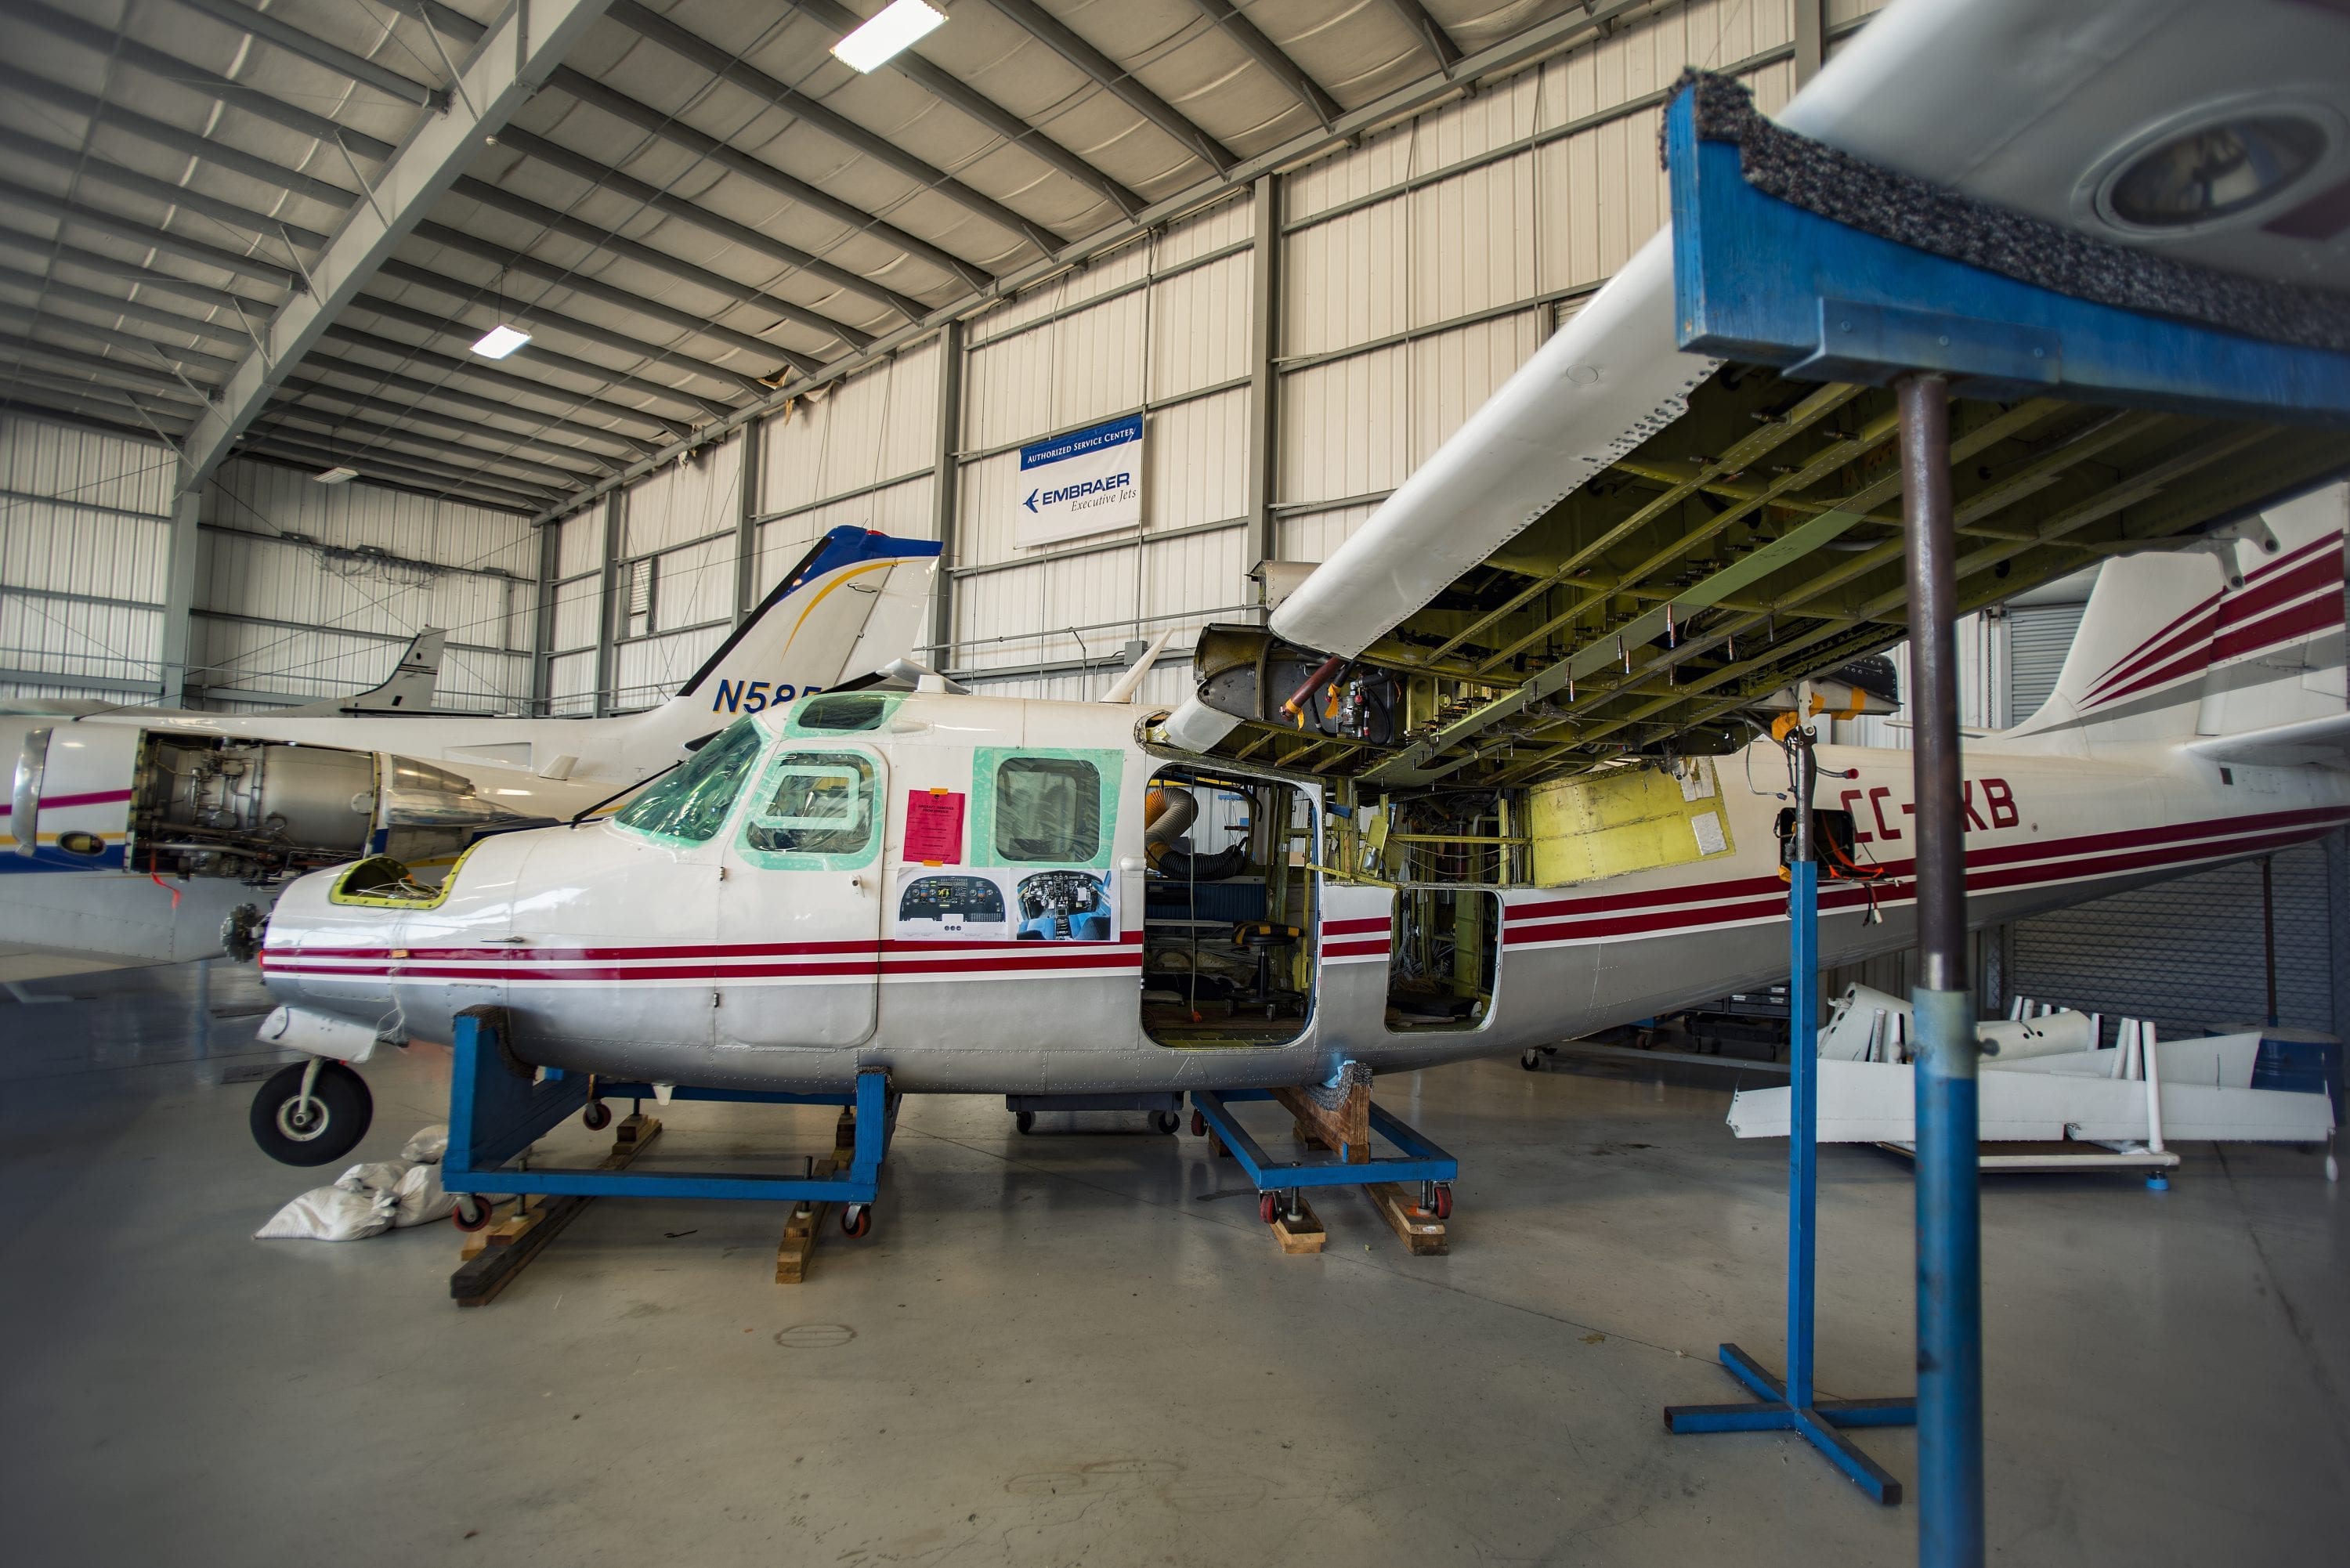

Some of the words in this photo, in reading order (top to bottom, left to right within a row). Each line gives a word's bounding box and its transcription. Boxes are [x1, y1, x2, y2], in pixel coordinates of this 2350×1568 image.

[1027, 446, 1072, 464] AUTHORIZED
[1074, 437, 1102, 451] SERVICE
[1104, 428, 1134, 443] CENTER
[1043, 472, 1130, 505] EMBRAER
[1072, 494, 1116, 511] Executive
[1119, 489, 1136, 503] Jets
[1841, 778, 2019, 844] CC-KB
